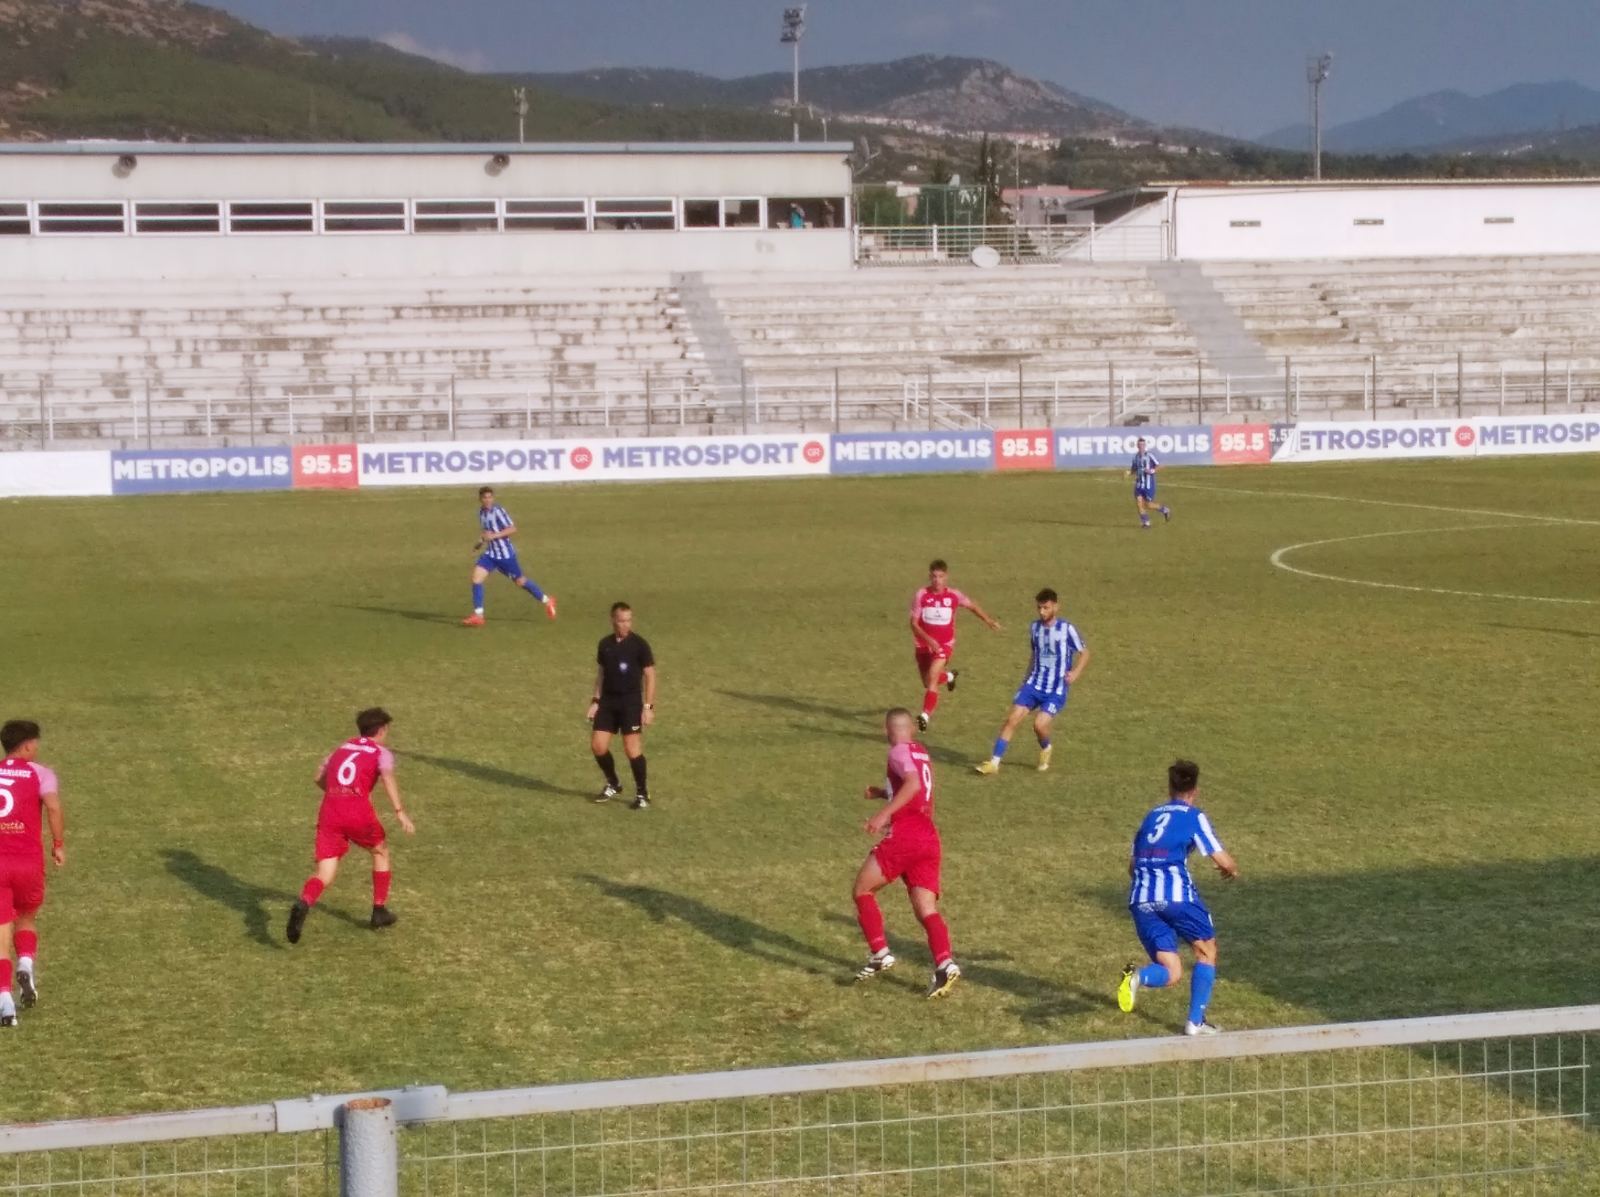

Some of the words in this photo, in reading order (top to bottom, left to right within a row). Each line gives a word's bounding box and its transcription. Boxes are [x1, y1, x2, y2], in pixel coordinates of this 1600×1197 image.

[835, 438, 991, 461] METROPOLIS
[1002, 437, 1048, 457] 95.5
[1059, 434, 1210, 456] METROPOLIS
[1220, 432, 1264, 452] 95.5
[1300, 427, 1451, 450] ETROSPORT
[114, 455, 289, 480] METROPOLIS
[301, 453, 352, 475] 95.5
[363, 447, 565, 474] METROSPORT
[603, 442, 798, 468] METROSPORT
[337, 752, 360, 785] 6
[1147, 812, 1171, 844] 3
